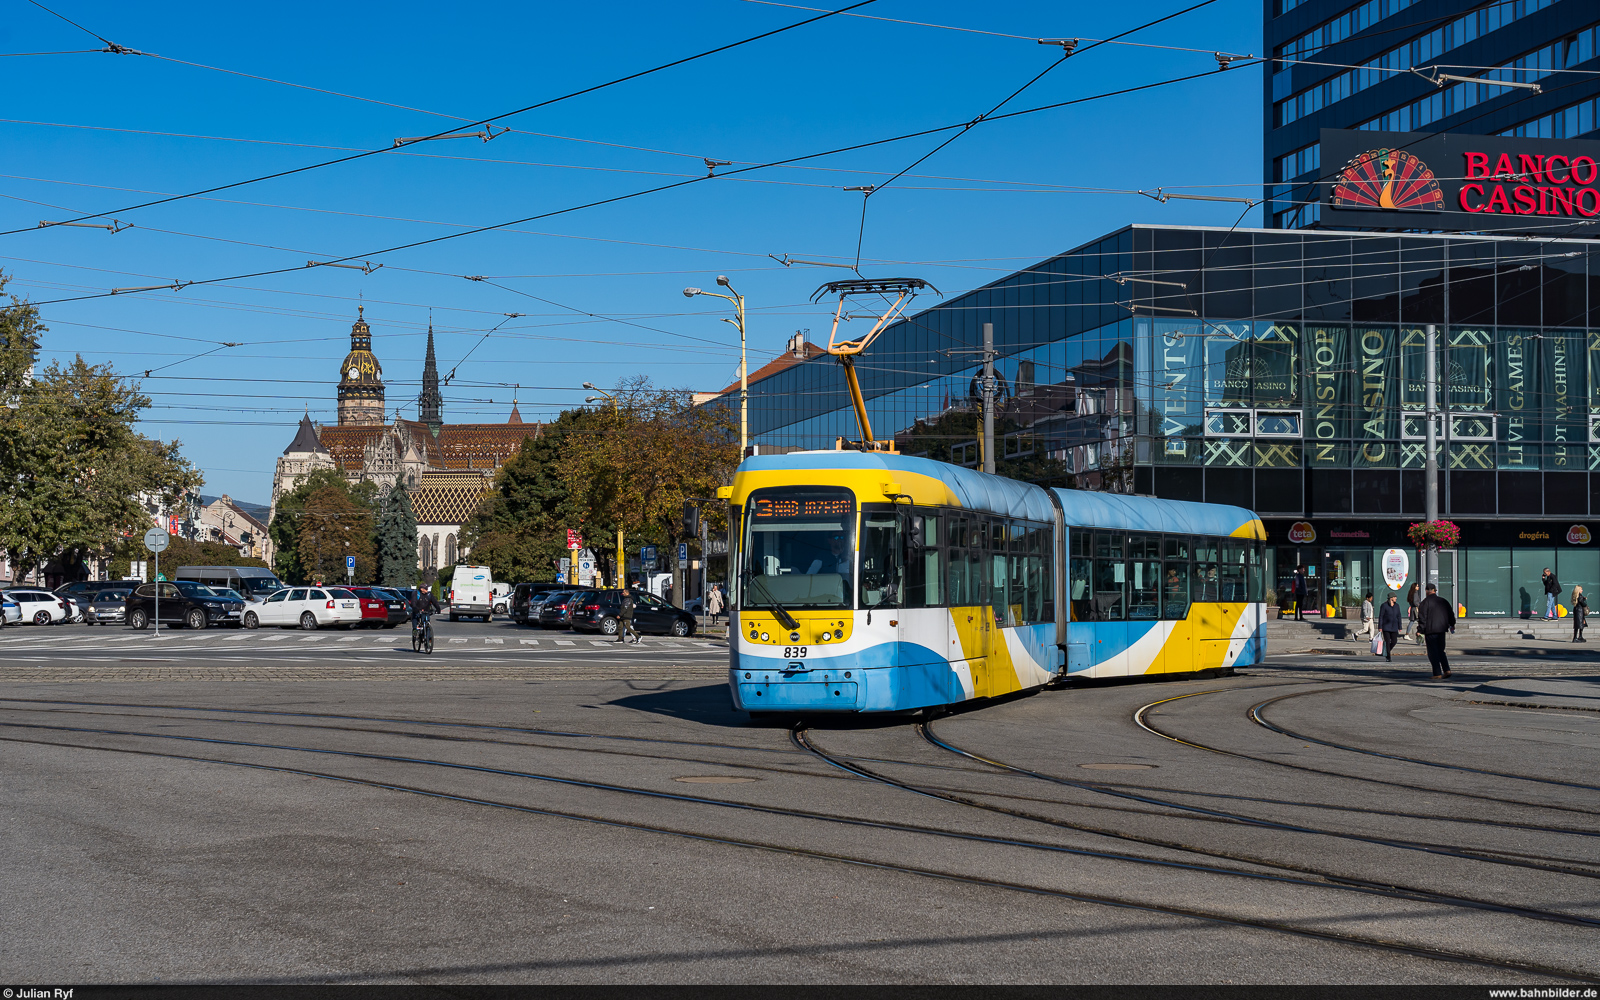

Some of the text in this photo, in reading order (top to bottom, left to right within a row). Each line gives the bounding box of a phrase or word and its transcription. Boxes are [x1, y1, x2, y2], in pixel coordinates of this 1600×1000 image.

[1464, 152, 1598, 185] BANCO
[1459, 184, 1600, 217] CASINO
[1214, 380, 1248, 389] BANCO
[1164, 331, 1187, 457] EVENTS
[1315, 329, 1335, 462] NONSTOP
[1361, 331, 1386, 462] CASINO
[1508, 335, 1524, 465] LIVE GAMES
[1554, 336, 1567, 466] SLOT MACHINES
[756, 499, 773, 517] 3
[775, 500, 799, 517] NAD
[1292, 529, 1313, 538] teta
[1330, 529, 1370, 538] kozmetika
[1518, 531, 1550, 541] drogéria
[1570, 532, 1588, 540] teta
[348, 557, 354, 567] P
[784, 646, 808, 659] 839
